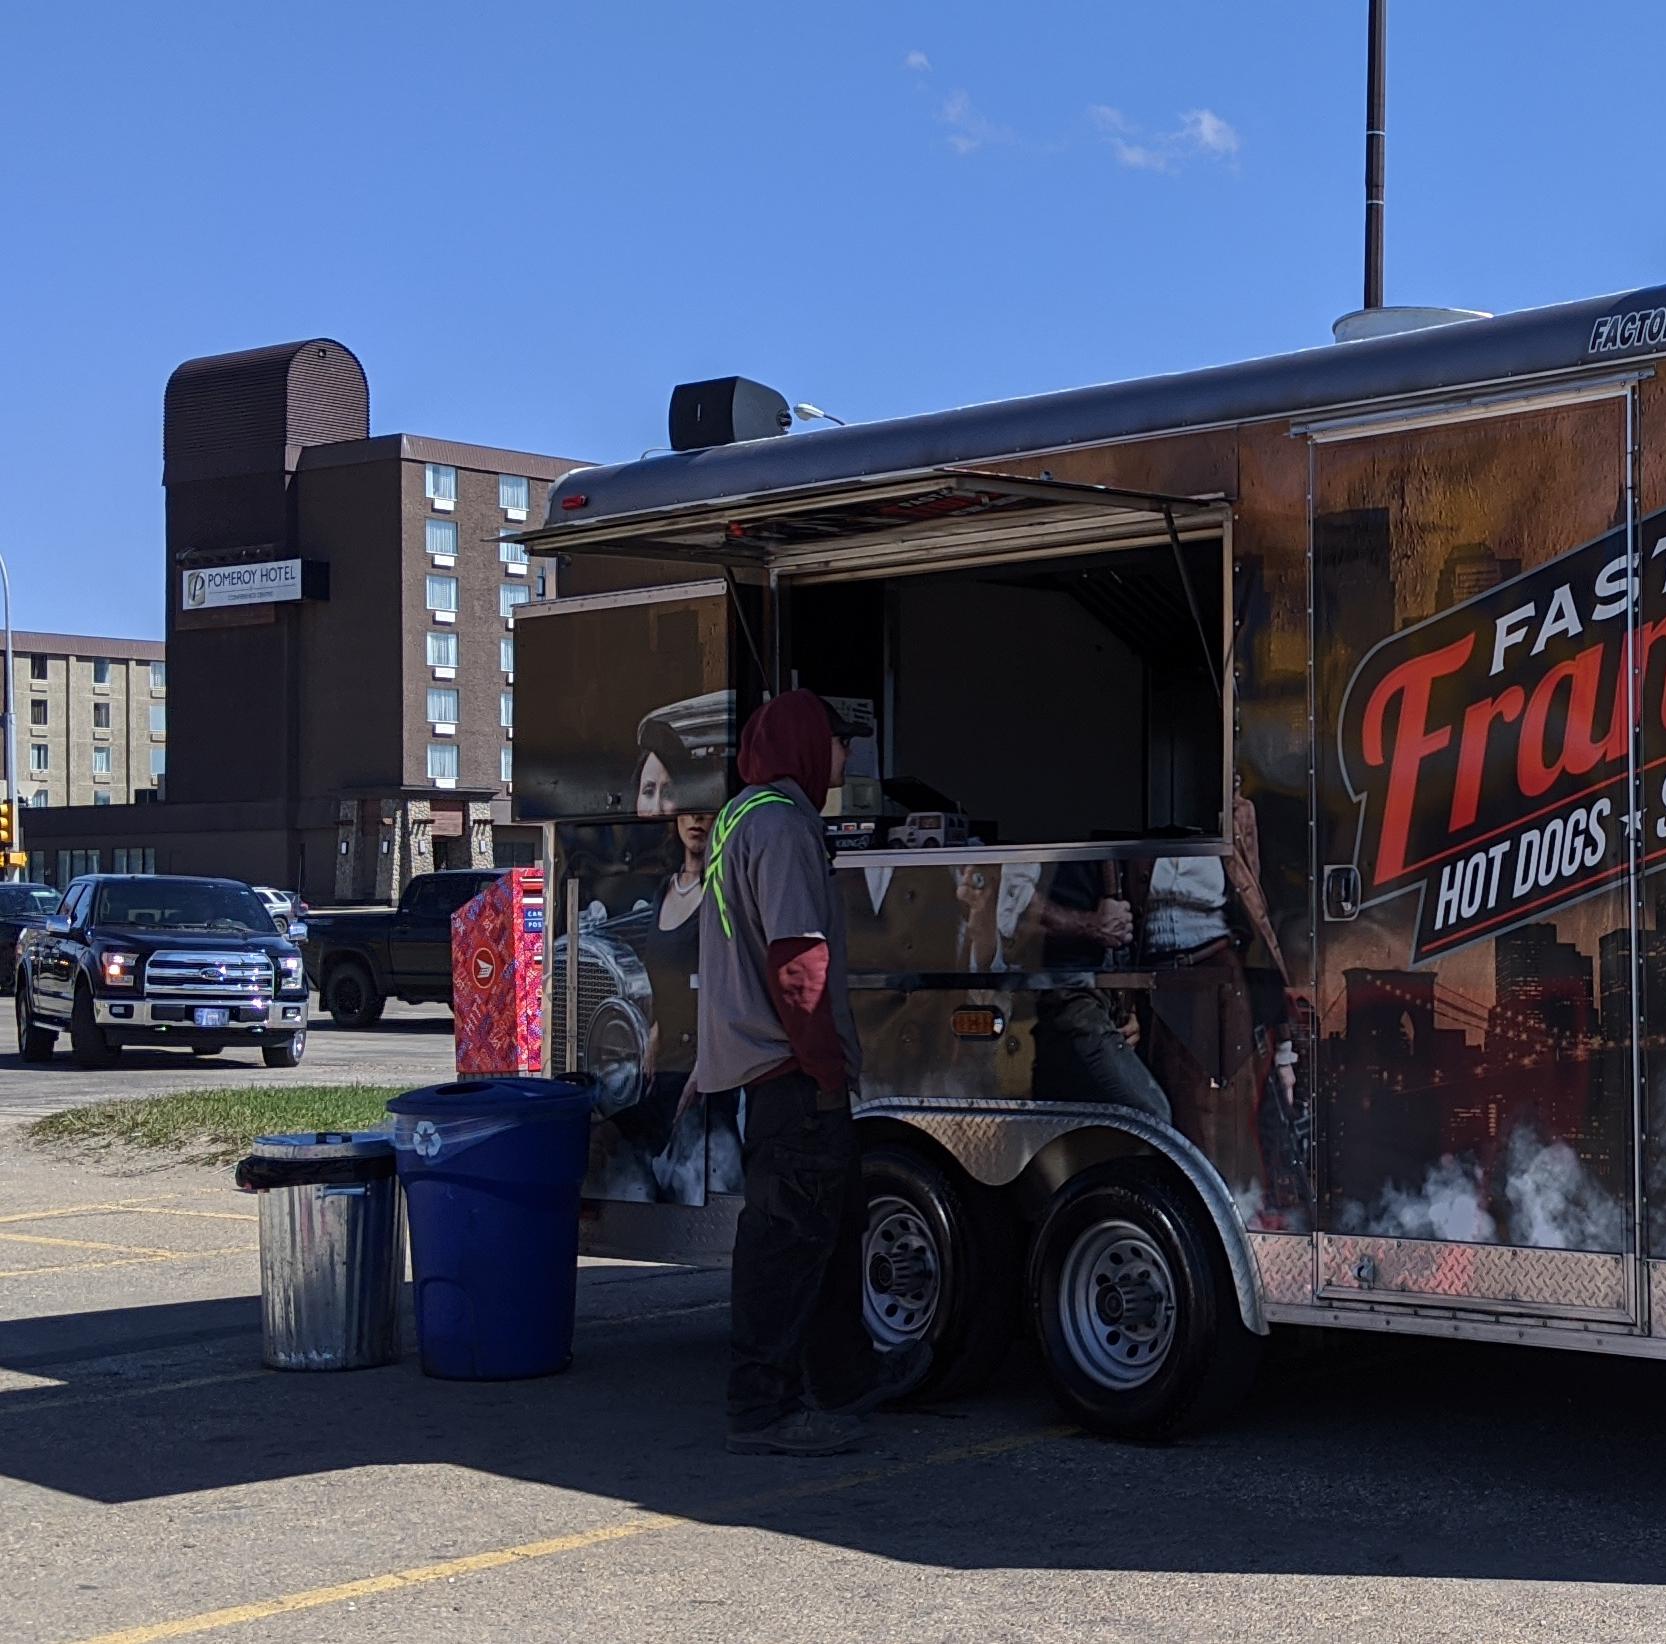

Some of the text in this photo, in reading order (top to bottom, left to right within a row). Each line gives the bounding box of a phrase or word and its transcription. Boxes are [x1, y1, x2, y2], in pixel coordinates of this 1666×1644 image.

[208, 565, 296, 588] POMEROY HOTEL
[1433, 846, 1511, 931] HOT
[1511, 797, 1613, 899] DOGS
[527, 910, 543, 918] CAN
[528, 921, 542, 929] POS
